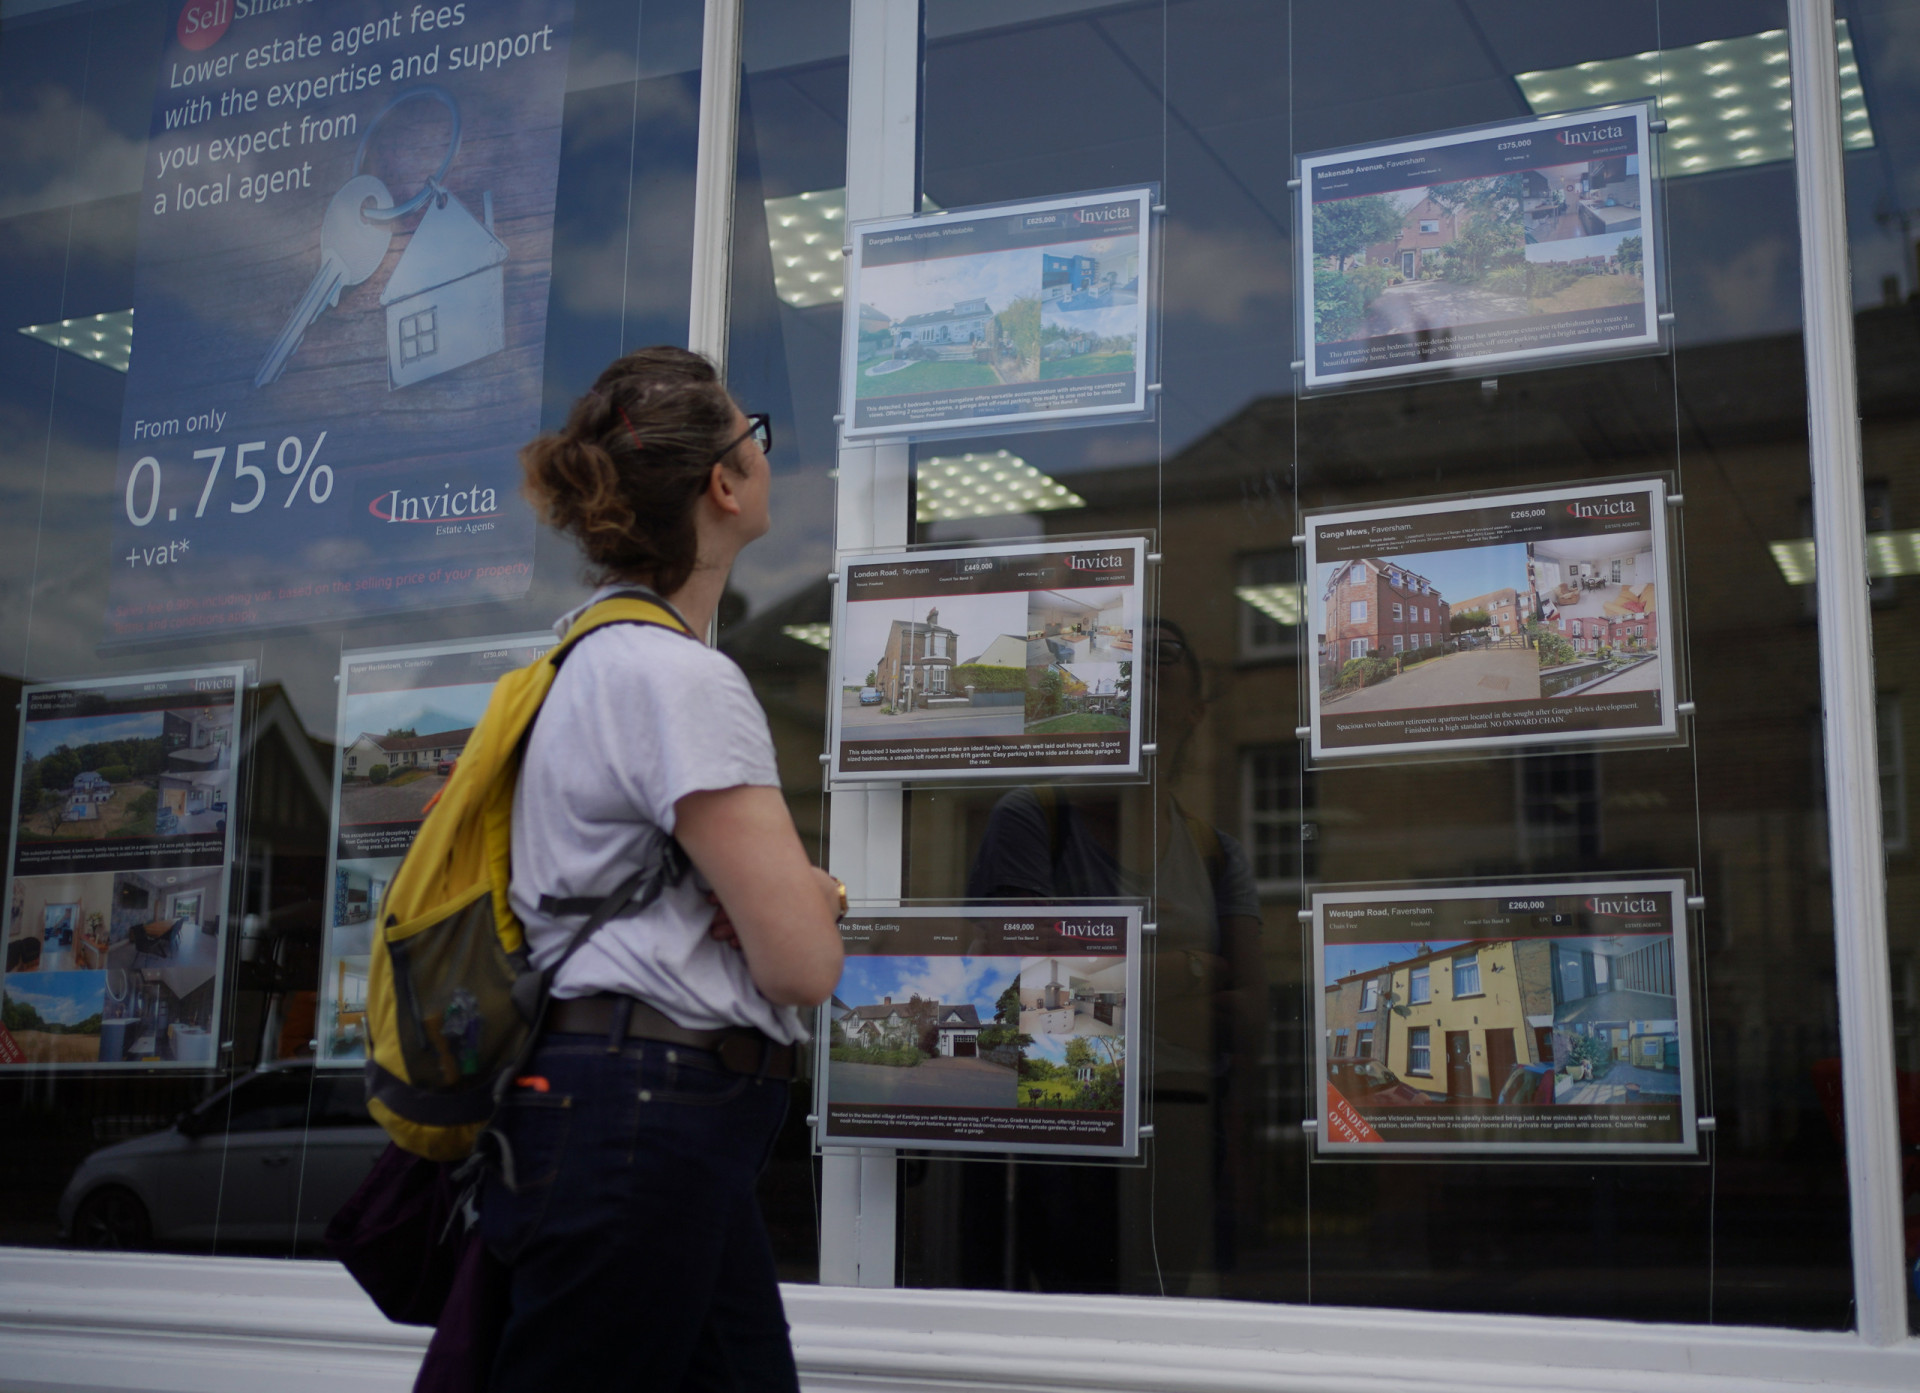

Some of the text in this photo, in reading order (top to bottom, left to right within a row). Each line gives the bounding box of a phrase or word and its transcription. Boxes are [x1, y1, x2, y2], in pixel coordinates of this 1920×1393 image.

[185, 0, 228, 35] Sell
[170, 3, 467, 89] Lower estate agent fees
[165, 24, 553, 130] with the expertise and support
[1564, 126, 1623, 146] Invicta
[157, 112, 357, 179] you expect from
[1497, 140, 1532, 151] £375,000
[1318, 158, 1426, 180] Makenade Avenue, Faversham
[153, 161, 312, 216] a local agent
[1080, 206, 1130, 223] Invicta
[869, 236, 893, 246] Dargate
[894, 234, 912, 242] Road,
[134, 408, 227, 440] From only
[125, 430, 334, 527] 0.75%
[387, 483, 498, 523] Invicta
[1575, 499, 1636, 518] Invicta
[1511, 508, 1545, 519] £265,000
[436, 522, 495, 537] Estate Agents
[1320, 524, 1413, 540] Gange Mews, Faversham.
[964, 562, 992, 572] £449,000
[1071, 553, 1123, 570] Invicta
[279, 584, 312, 600] based
[315, 584, 329, 594] on
[332, 580, 351, 592] the
[355, 577, 391, 591] selling
[396, 574, 425, 588] price
[428, 569, 443, 584] of
[445, 568, 472, 584] your
[476, 562, 530, 580] property
[854, 570, 878, 578] London
[880, 568, 898, 578] Road,
[351, 665, 368, 674] Upper
[195, 677, 234, 692] Invicta
[1438, 715, 1468, 723] apartment
[1329, 907, 1434, 918] Westgate Road, Faversham.
[1508, 901, 1544, 910] £260,000
[1593, 896, 1656, 914] Invicta
[852, 924, 874, 932] Street,
[874, 924, 900, 932] Eastling
[1003, 923, 1034, 932] £849,000
[1061, 920, 1114, 936] Invicta
[1329, 1111, 1360, 1143] OFFER
[1338, 1100, 1370, 1138] UNDER
